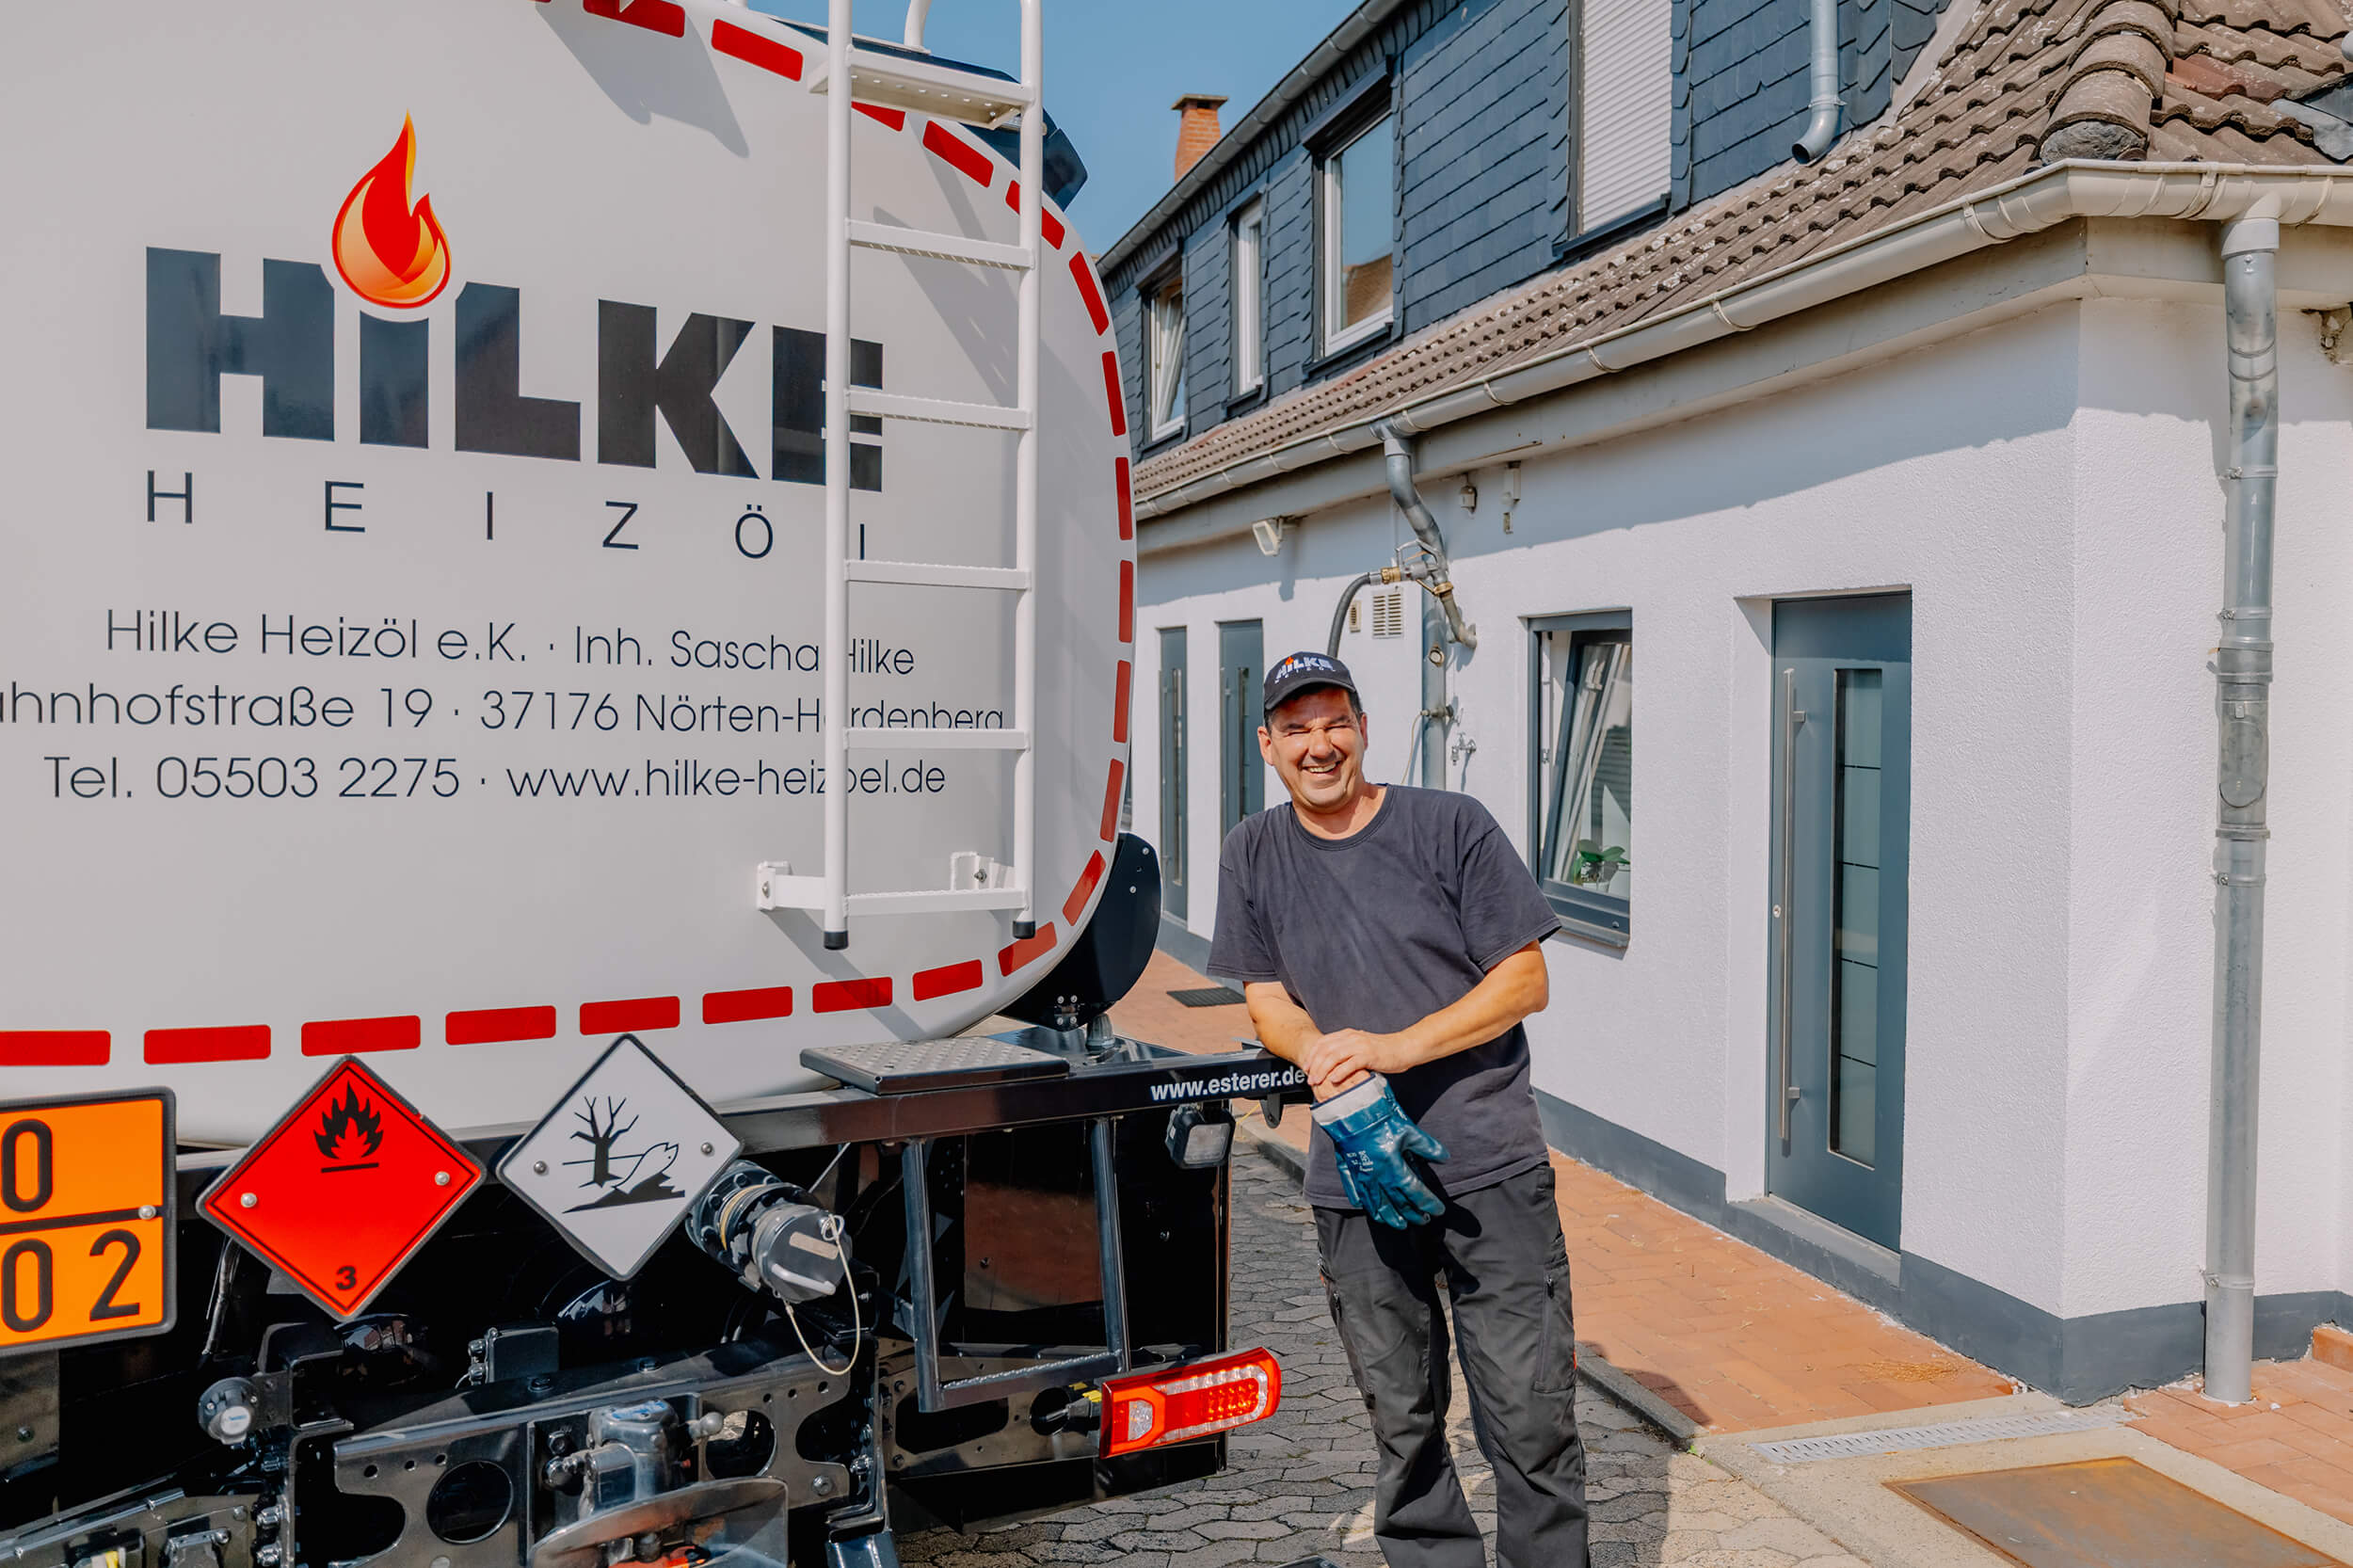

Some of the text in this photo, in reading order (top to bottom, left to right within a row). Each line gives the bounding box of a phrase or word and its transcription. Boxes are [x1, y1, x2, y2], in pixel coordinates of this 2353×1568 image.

[107, 609, 238, 654] Hilke
[262, 614, 417, 659] Heizöl
[437, 621, 525, 662] e.K.
[576, 625, 652, 666] Inh.
[670, 630, 820, 672] Sascha
[0, 680, 1004, 731] hnhofstraße 19 37176 Nörten-Hrdenber
[43, 756, 132, 799] Tel.
[156, 756, 318, 799] 05503
[338, 757, 459, 798] 2275
[1150, 1065, 1306, 1101] www.esterer.de
[336, 1265, 357, 1290] 3
